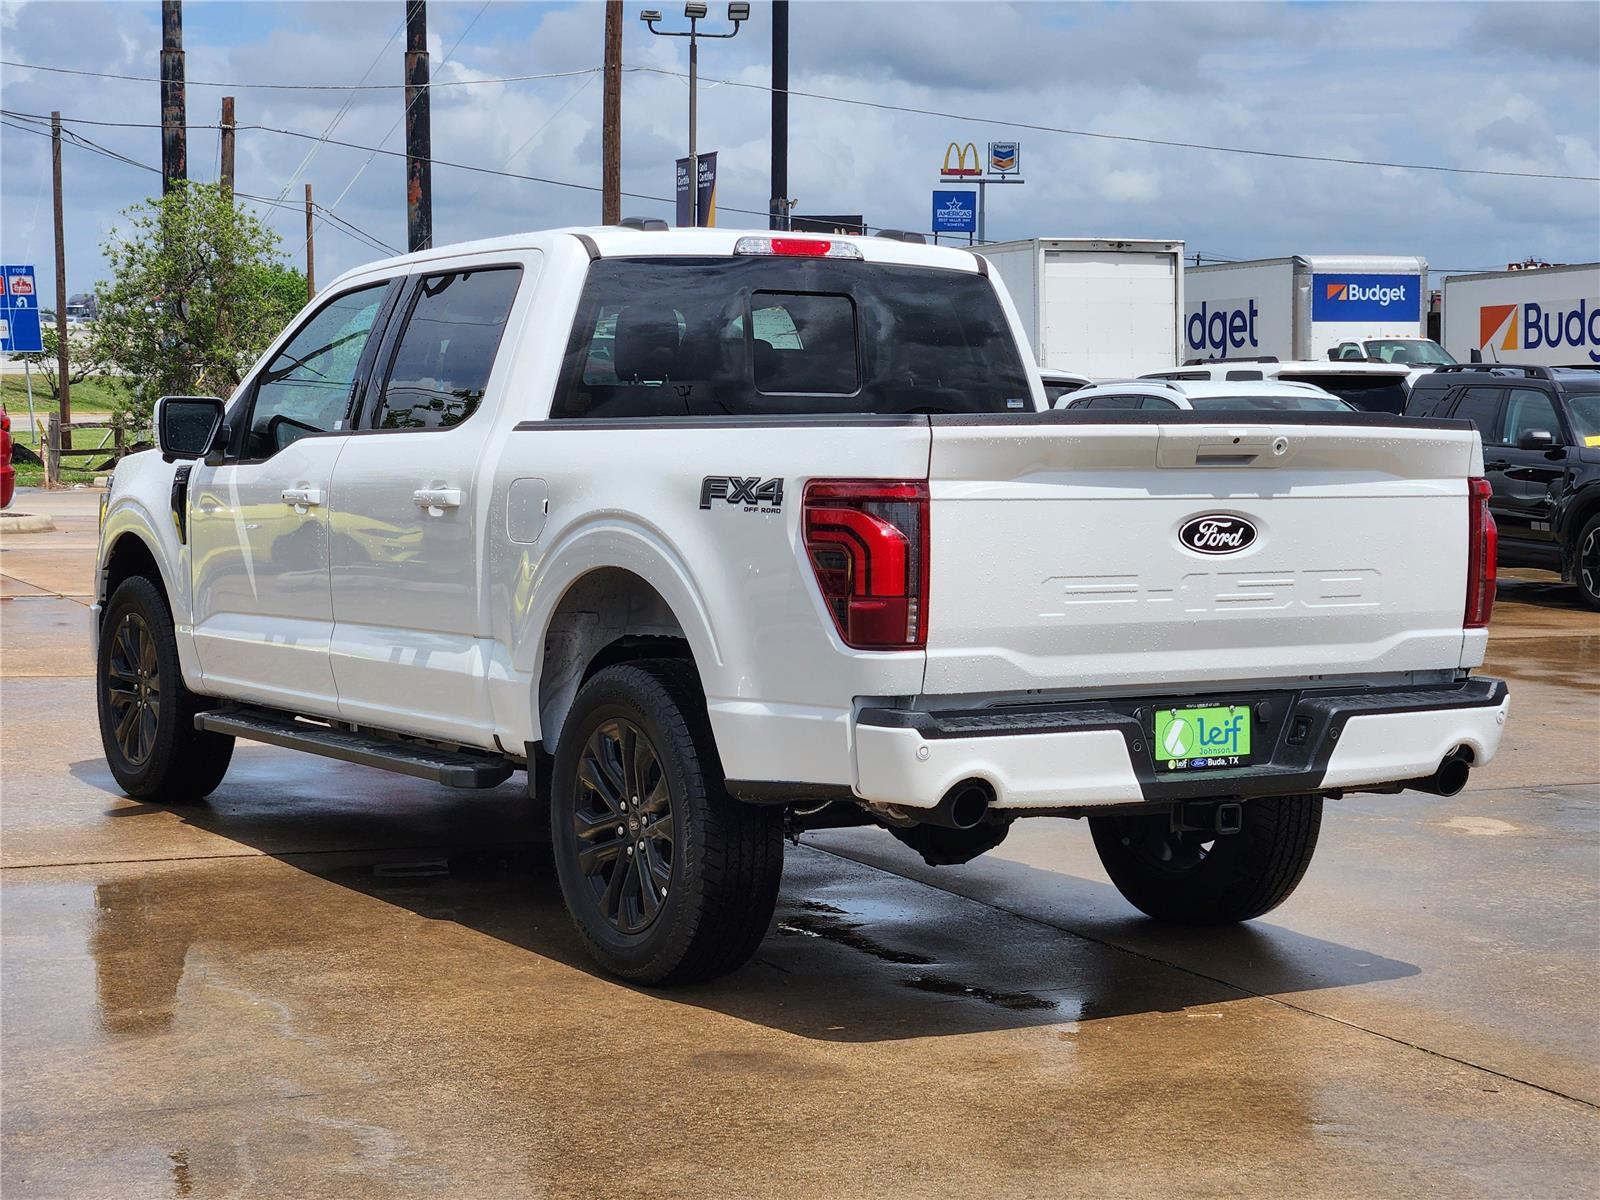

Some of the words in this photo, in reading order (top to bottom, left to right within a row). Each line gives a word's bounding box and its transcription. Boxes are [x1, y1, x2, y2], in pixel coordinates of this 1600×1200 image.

[678, 167, 686, 176] Blue
[699, 162, 708, 172] Gold
[1348, 283, 1406, 306] Budget
[699, 475, 785, 510] FX4
[1193, 520, 1245, 547] Ford
[1196, 714, 1244, 753] leif
[1199, 747, 1231, 755] Johnson
[1207, 757, 1227, 766] Buda,
[1228, 756, 1239, 765] TX
